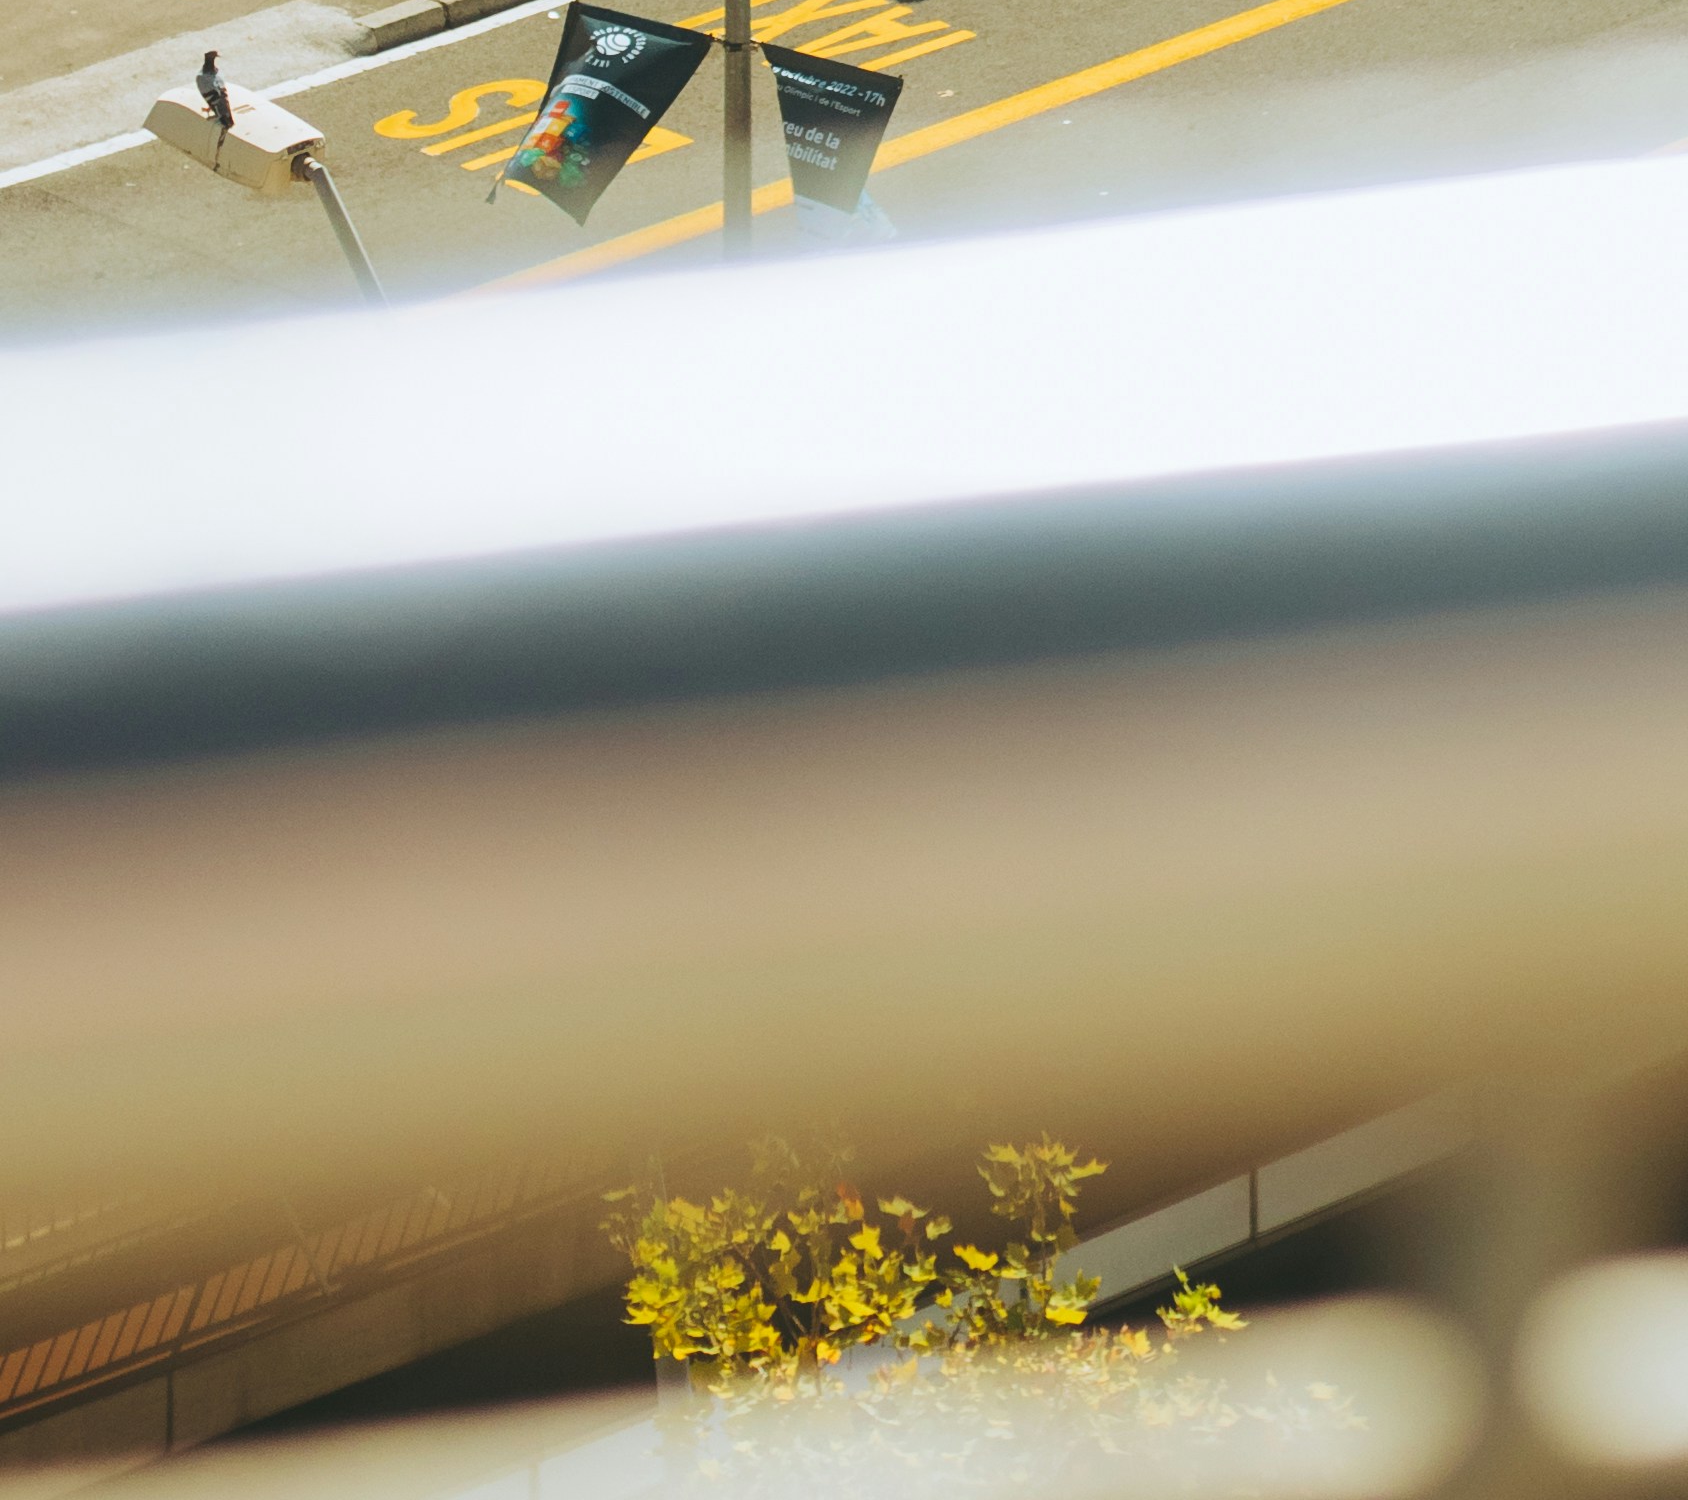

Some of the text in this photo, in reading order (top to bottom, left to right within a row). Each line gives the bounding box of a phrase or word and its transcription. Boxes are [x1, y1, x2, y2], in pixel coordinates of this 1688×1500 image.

[781, 68, 826, 89] octubre
[826, 81, 857, 97] 2022
[600, 82, 648, 117] SOSTENIBLE
[819, 96, 829, 107] de
[830, 100, 861, 117] l'Esport
[805, 127, 824, 144] de
[825, 132, 841, 150] la
